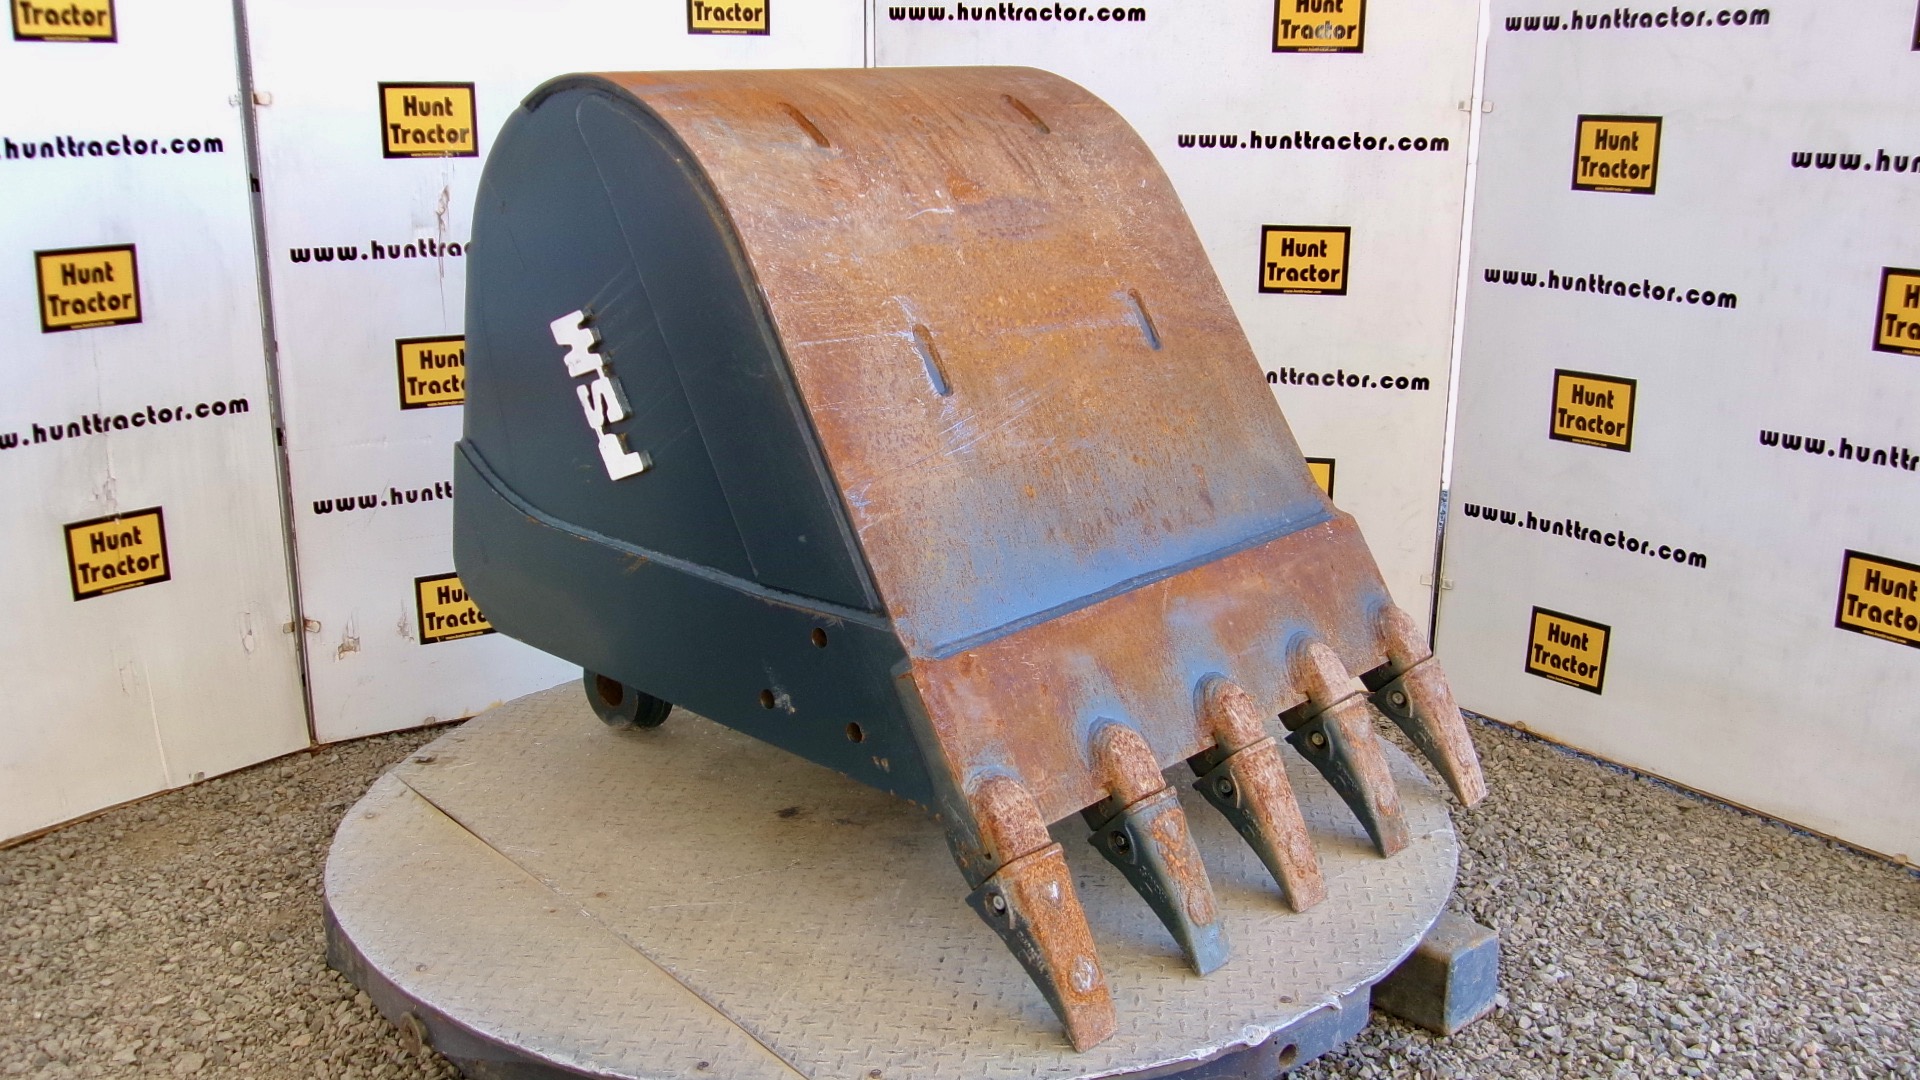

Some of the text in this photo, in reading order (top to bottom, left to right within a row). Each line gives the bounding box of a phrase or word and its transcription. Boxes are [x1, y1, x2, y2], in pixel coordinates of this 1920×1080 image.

[20, 1, 106, 26] Tractor
[694, 1, 762, 21] Tractor
[889, 3, 1145, 21] www.hunttractor.com
[1506, 7, 1769, 31] www.hunttractor.com
[1281, 20, 1356, 39] Tractor
[403, 96, 453, 116] Hunt
[390, 124, 469, 143] Tractor
[1178, 131, 1449, 151] www.hunttractor.com
[1595, 129, 1638, 151] Hunt
[0, 134, 224, 159] hunttractor.com
[1581, 156, 1650, 179] Tractor
[1281, 238, 1327, 257] Hunt
[62, 262, 113, 285] Hunt
[1267, 262, 1340, 282] Tractor
[1485, 269, 1737, 308] www.hunttractor.com
[48, 291, 132, 317] Tractor
[1572, 384, 1614, 409] Hunt
[1558, 407, 1625, 437] Tractor
[90, 526, 142, 554] Hunt
[1465, 503, 1706, 568] www.hunttractor.com
[78, 553, 160, 584] Tractor
[1864, 568, 1917, 602] Hunt
[1847, 593, 1920, 634] Tracto
[1548, 622, 1588, 652] Hunt
[1534, 643, 1598, 679] Tractor
